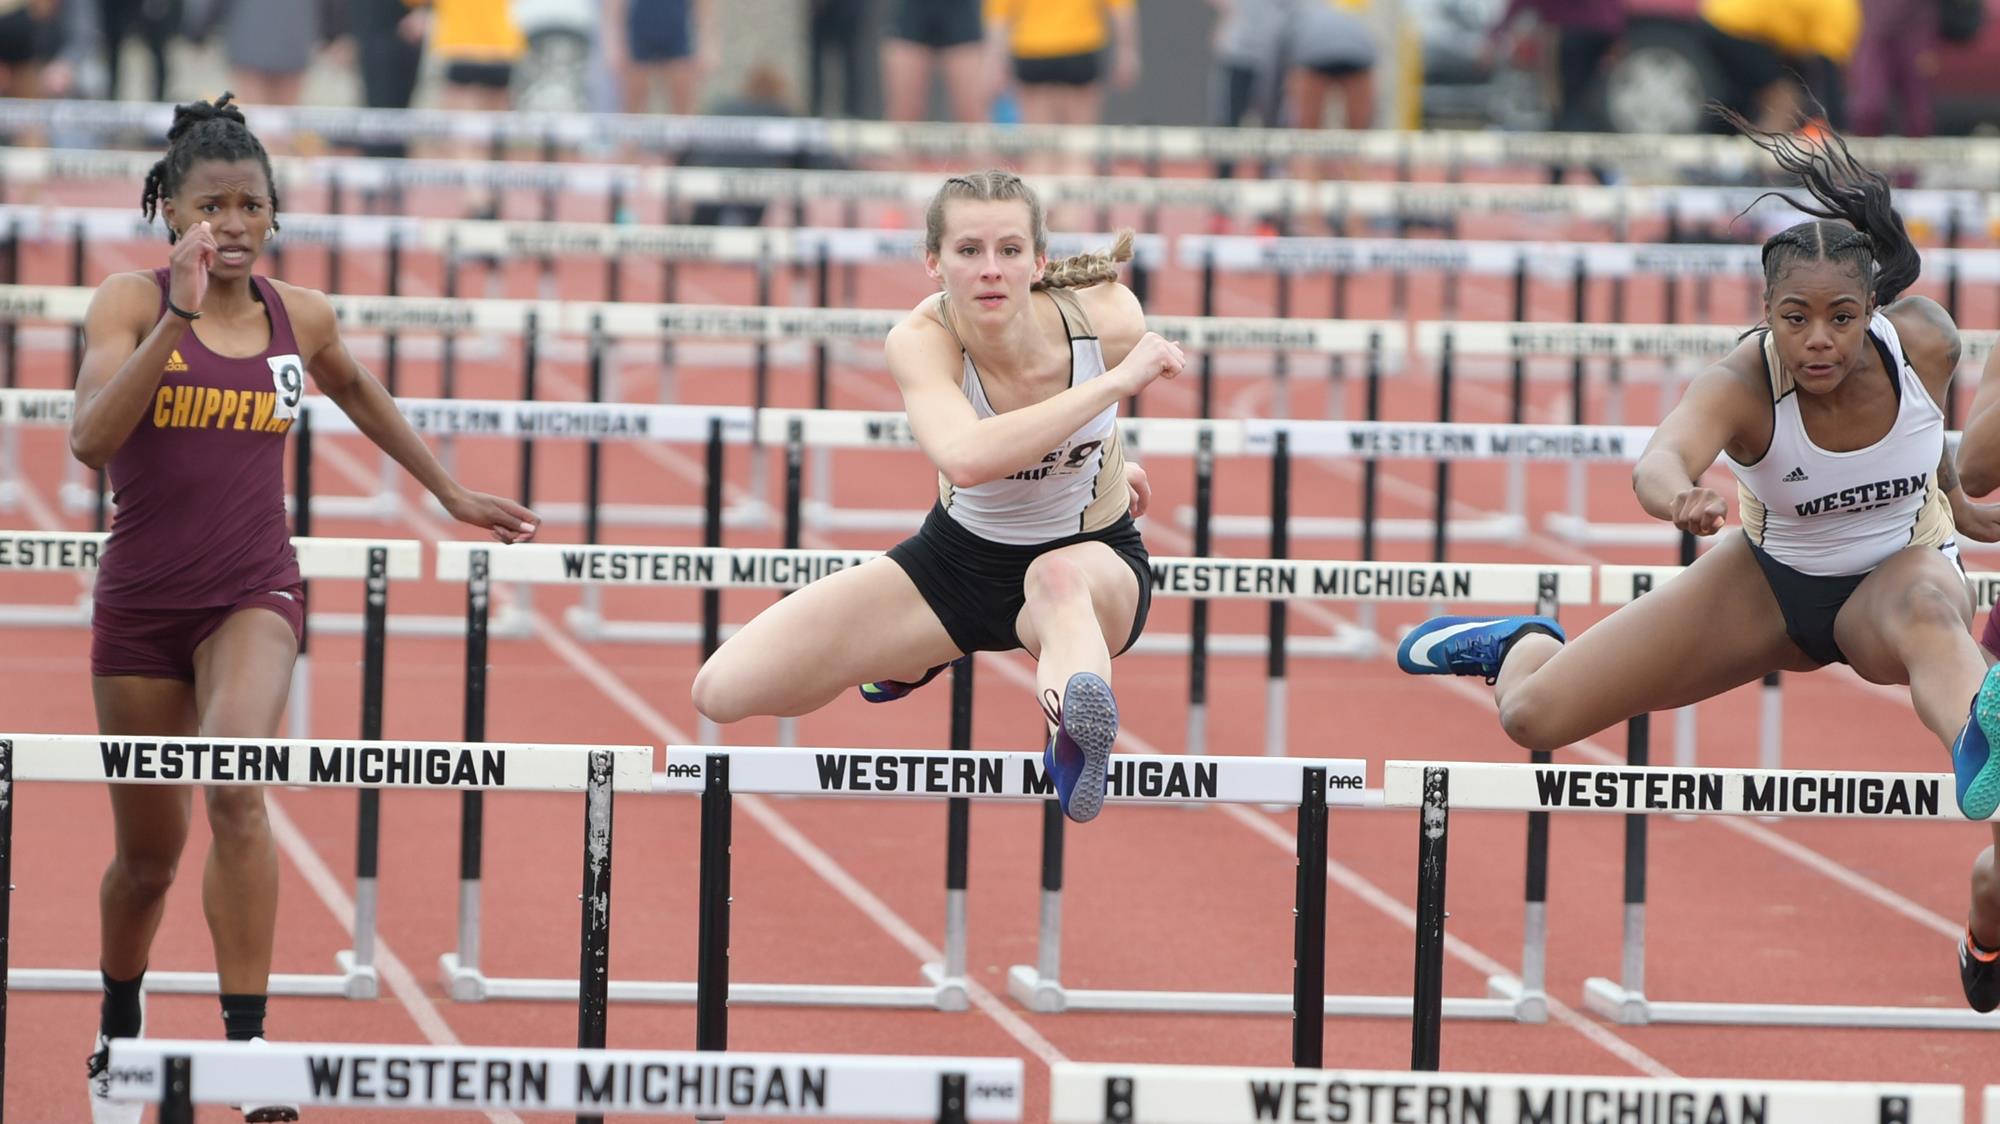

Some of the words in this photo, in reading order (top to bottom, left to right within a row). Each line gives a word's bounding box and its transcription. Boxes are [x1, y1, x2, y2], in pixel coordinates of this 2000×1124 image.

[281, 364, 301, 407] 9
[153, 385, 294, 433] CHIPPEW
[411, 406, 501, 431] STERN
[1349, 428, 1477, 453] WESTERN
[1490, 432, 1625, 456] MICHIGAN
[1795, 472, 1928, 517] WESTERN
[0, 538, 99, 568] ESTER
[562, 551, 714, 582] WESTERN
[731, 555, 867, 585] MICHIG
[1151, 563, 1297, 594] WESTERN
[1313, 566, 1472, 597] MICHIGAN
[101, 741, 290, 782] WESTERN
[309, 745, 506, 786] MICHIGAN
[816, 753, 1004, 794] WESTERN
[1023, 758, 1218, 798] MHIGAN
[1536, 769, 1724, 811] WESTERN
[1742, 774, 1940, 816] MICHIGAN
[308, 1055, 549, 1104] WESTERN
[575, 1061, 828, 1109] MICHIGAN
[1250, 1080, 1489, 1124] WESTERN
[1518, 1087, 1768, 1124] MICHIGAN
